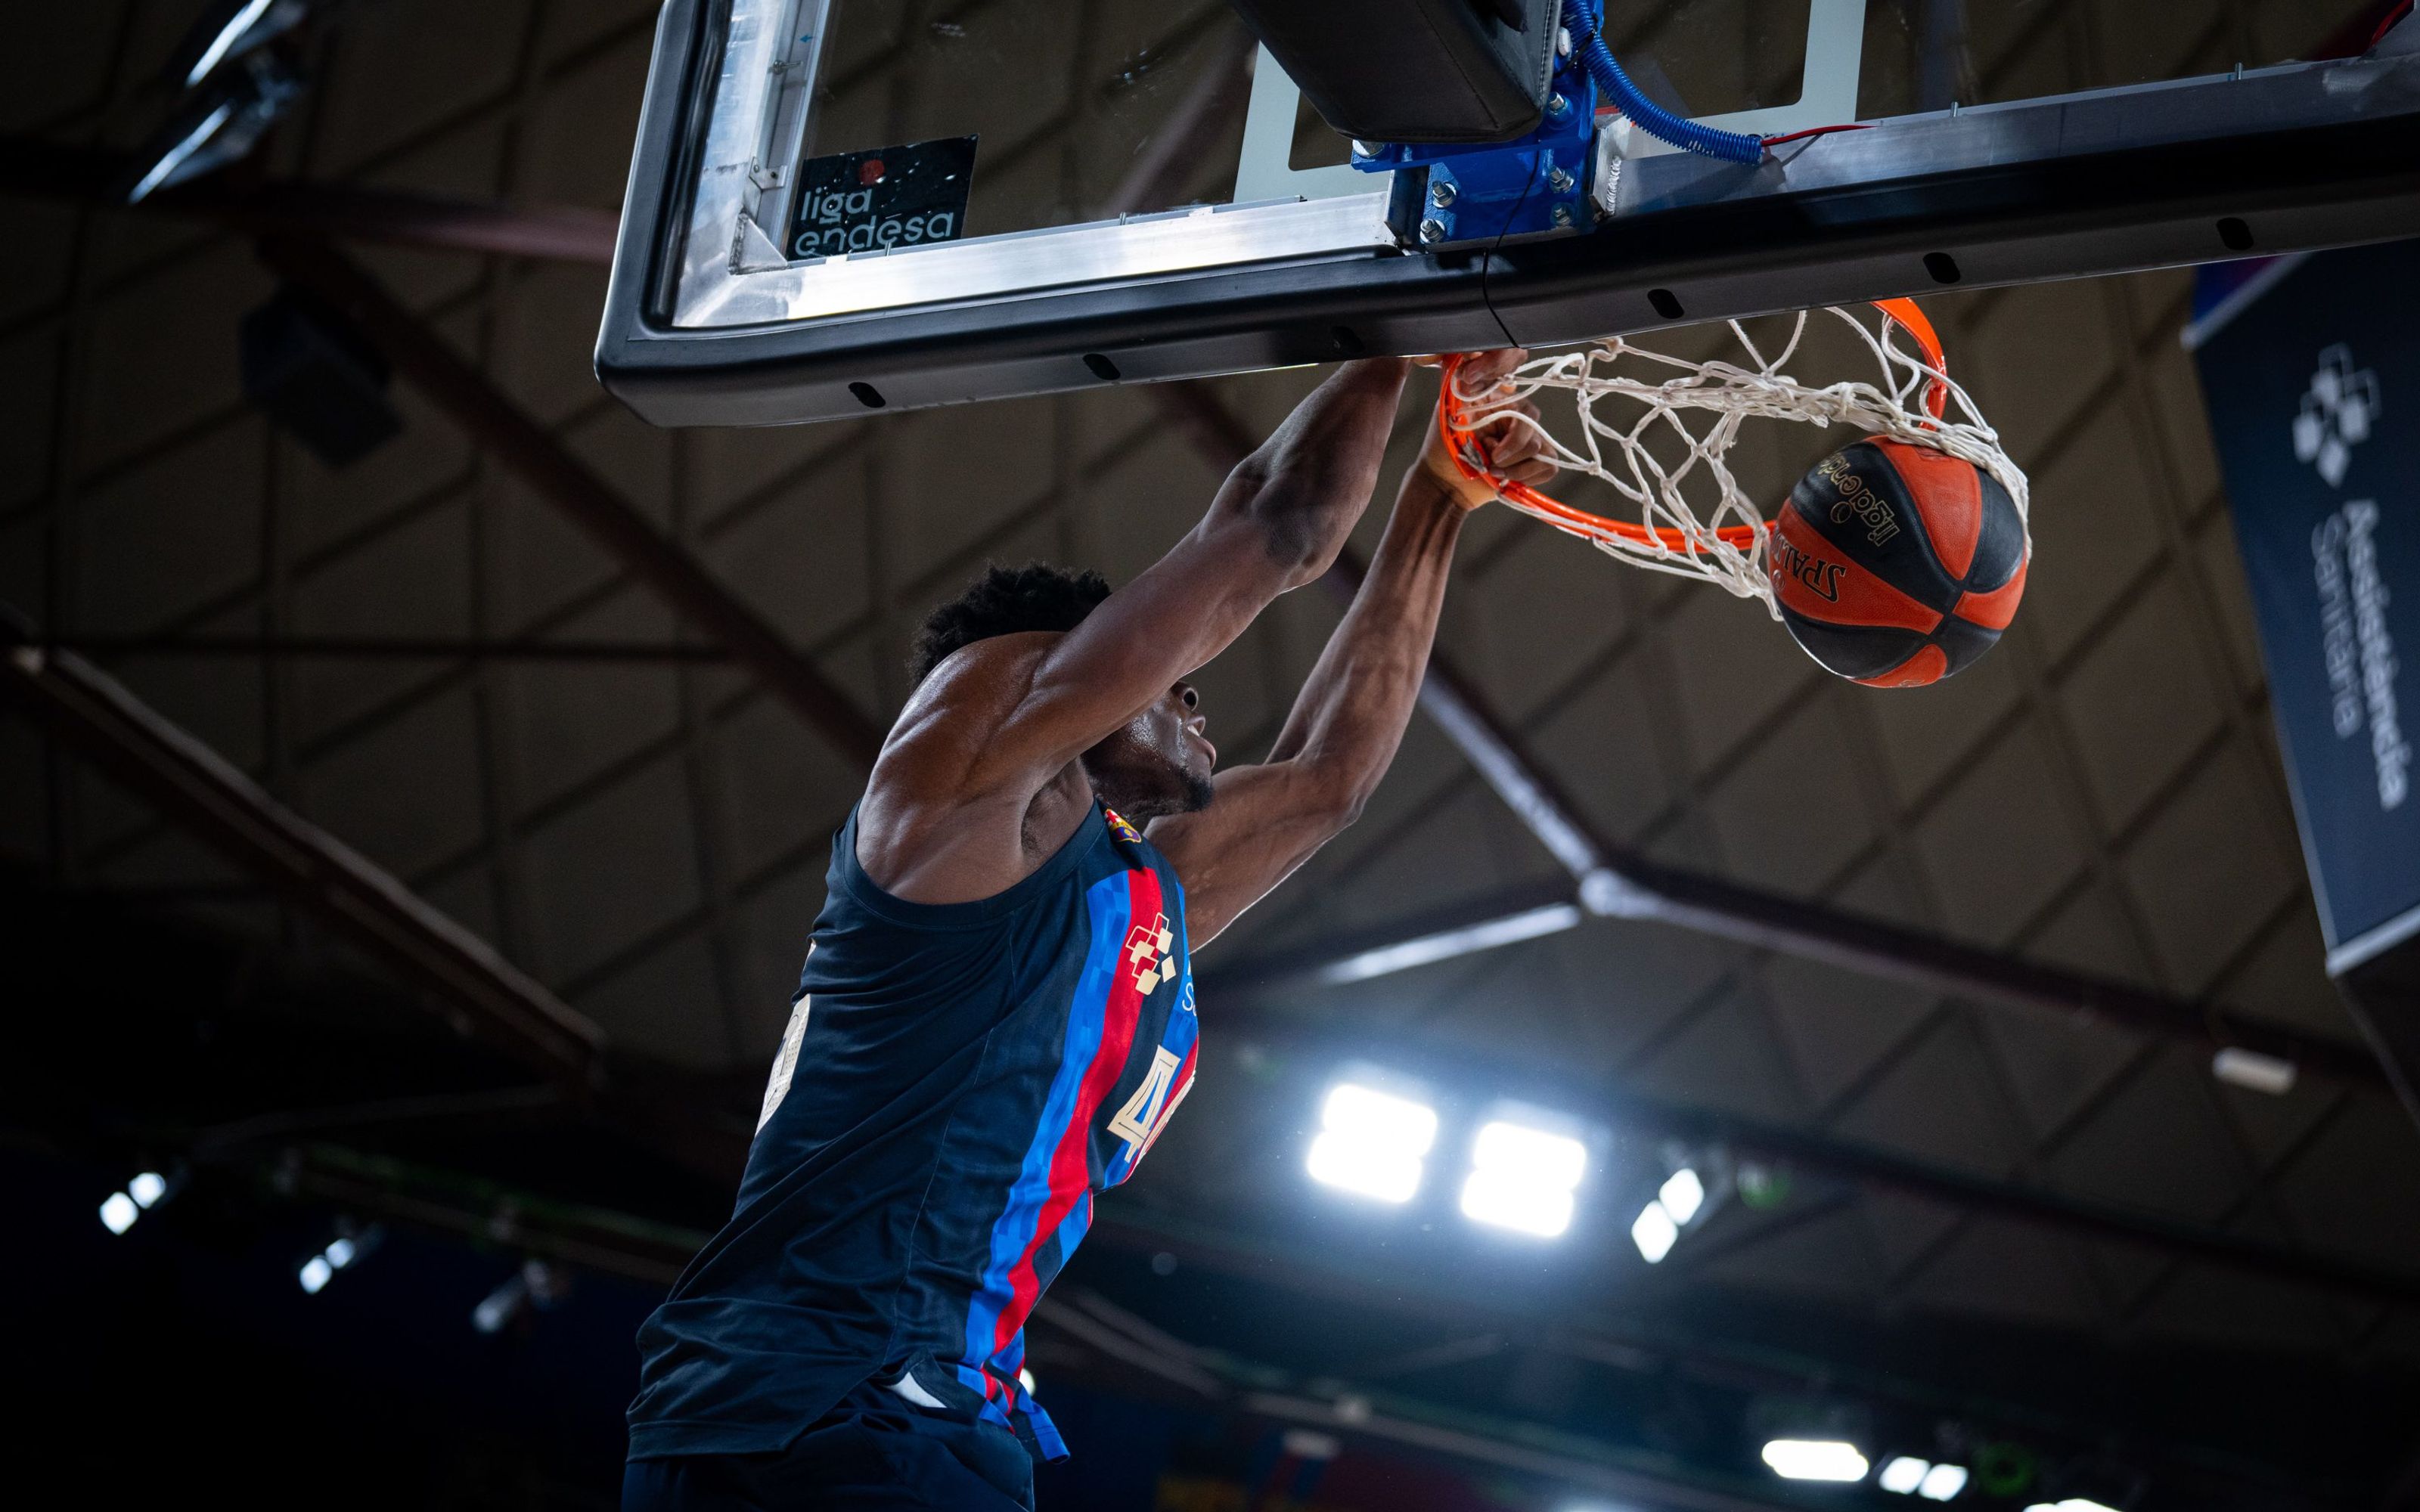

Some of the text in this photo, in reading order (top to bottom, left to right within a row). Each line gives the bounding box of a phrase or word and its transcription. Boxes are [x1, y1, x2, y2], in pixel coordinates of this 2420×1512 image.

[800, 187, 872, 225] liga
[795, 212, 954, 256] endesa
[1107, 1044, 1196, 1166] 4
